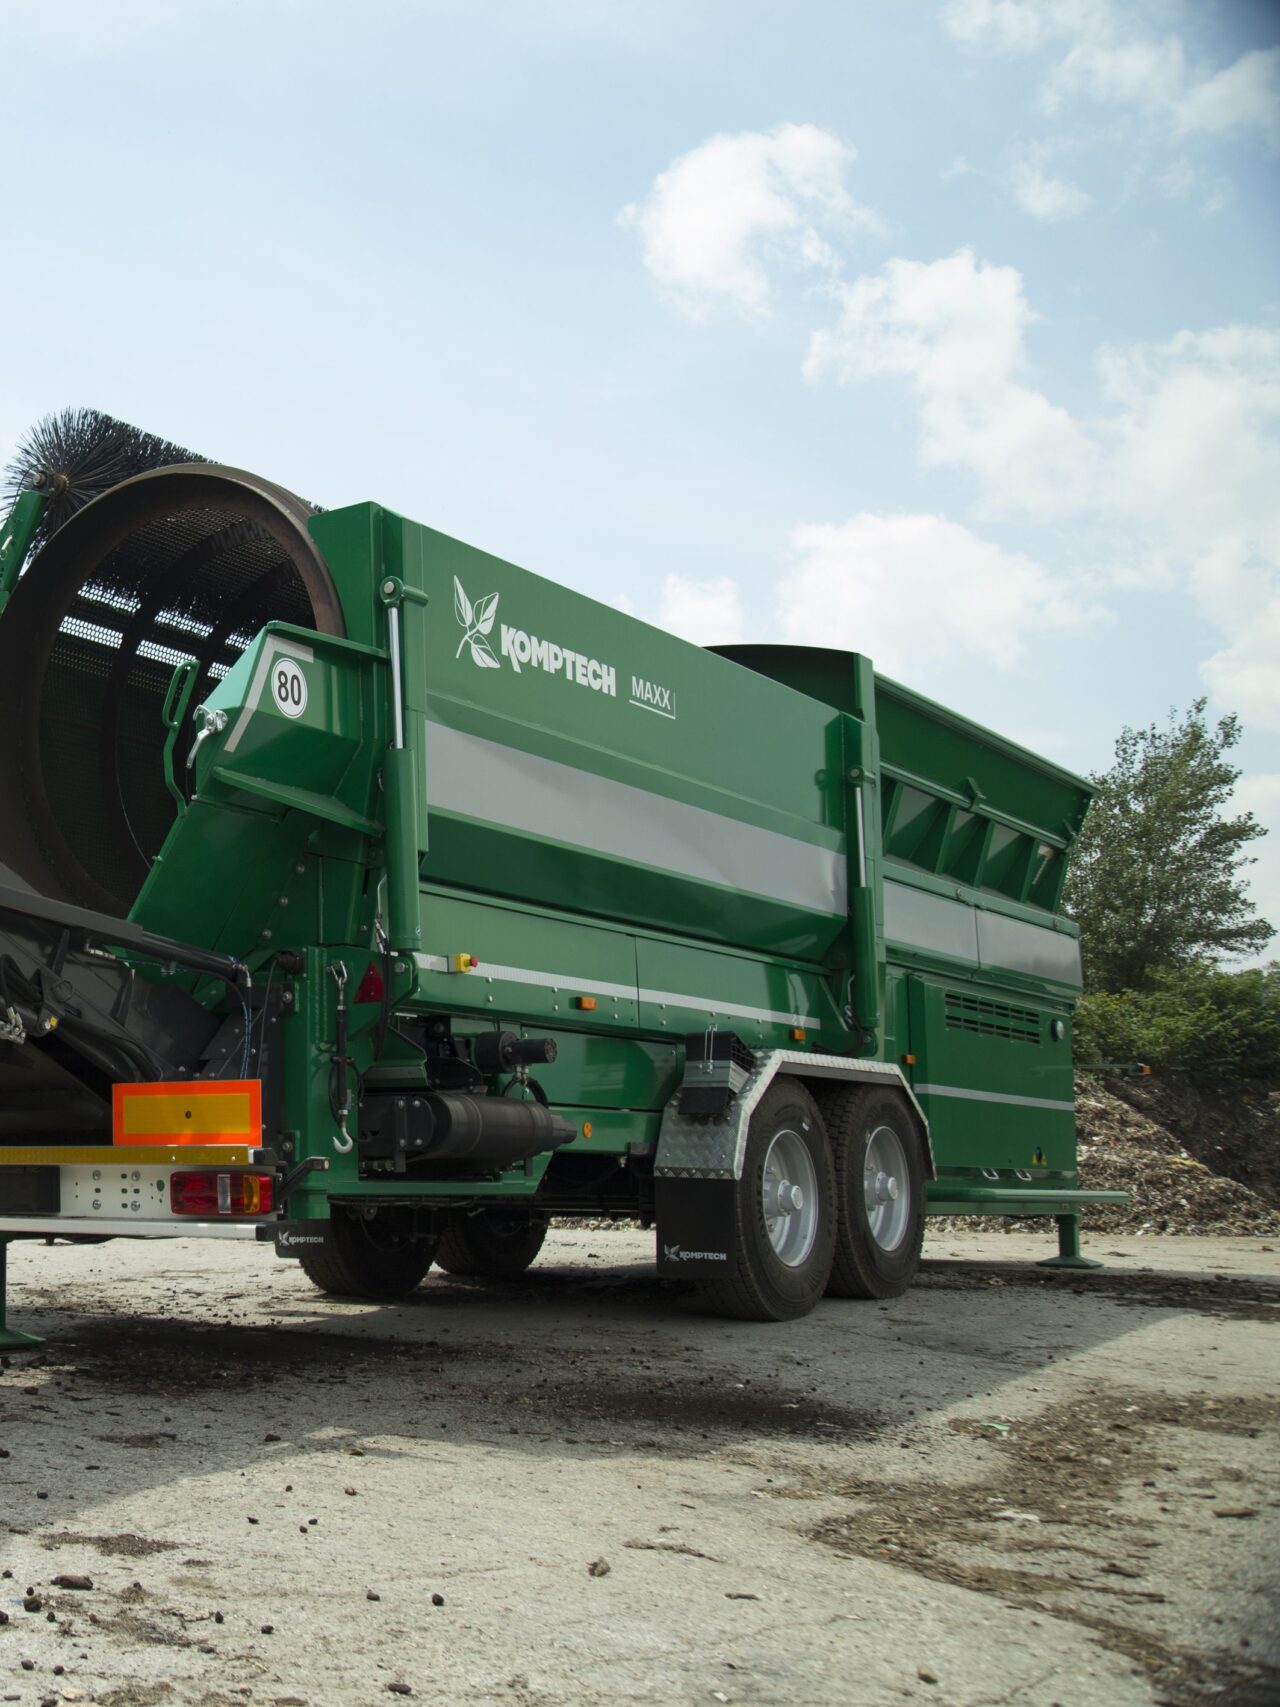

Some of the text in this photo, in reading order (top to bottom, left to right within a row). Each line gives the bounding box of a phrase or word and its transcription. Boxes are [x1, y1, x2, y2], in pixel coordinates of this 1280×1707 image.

[500, 623, 672, 711] KOMPTECH MAXX
[277, 670, 302, 706] 80
[679, 1250, 727, 1261] KOMPTECH
